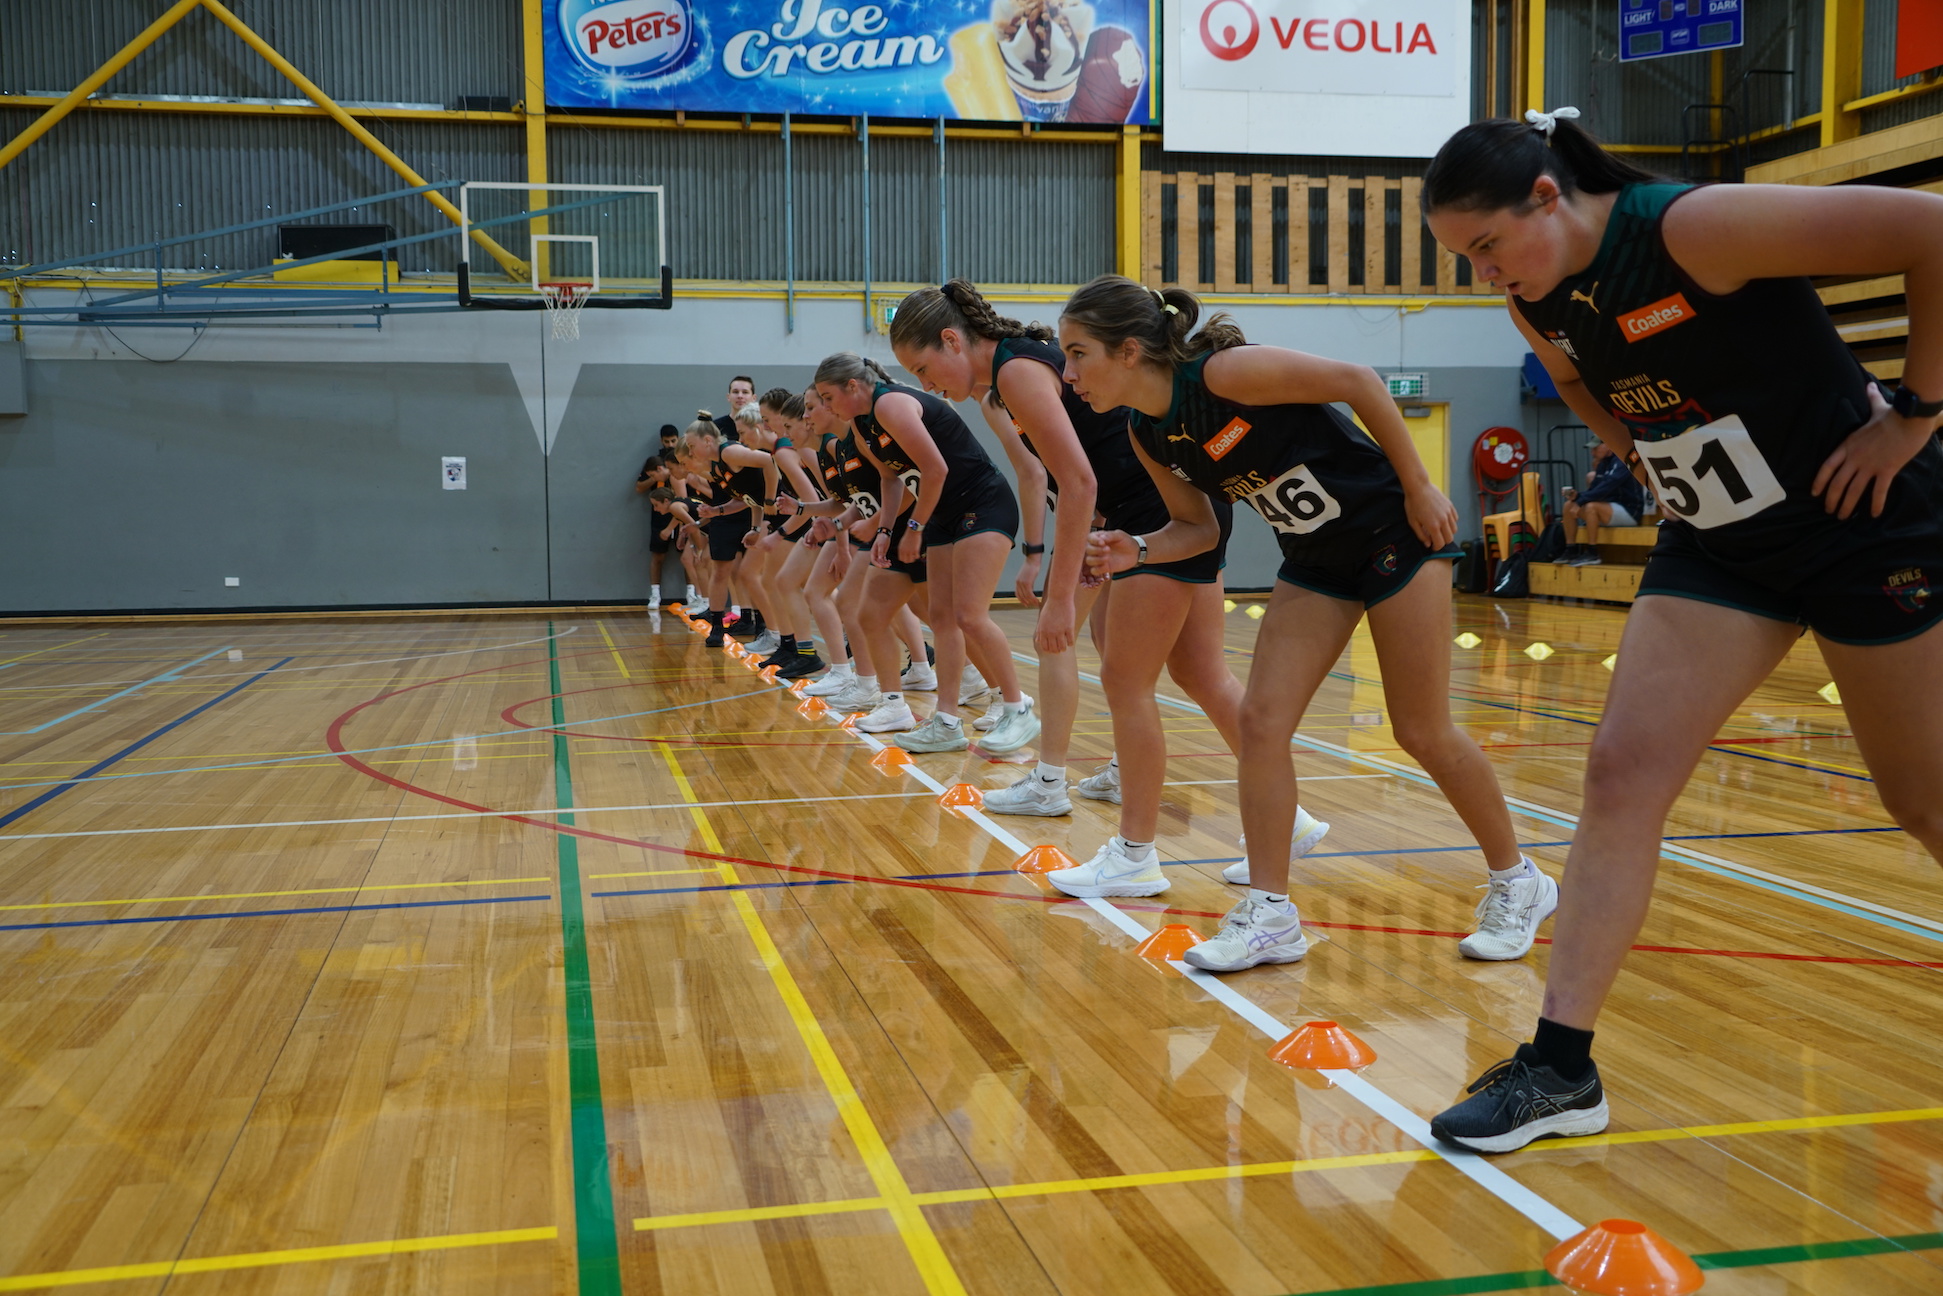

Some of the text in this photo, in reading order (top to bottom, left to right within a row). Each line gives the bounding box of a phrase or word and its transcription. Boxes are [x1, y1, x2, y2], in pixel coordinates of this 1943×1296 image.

[582, 11, 682, 55] Peters
[771, 0, 889, 41] Ice
[1269, 16, 1438, 55] VEOLIA
[722, 30, 945, 80] Cream
[1627, 304, 1683, 334] Coates
[1609, 380, 1681, 414] DEVILS
[1610, 373, 1651, 391] TASMANIA
[1210, 425, 1244, 455] Coates
[1647, 438, 1753, 516] 51
[1254, 478, 1326, 527] 46
[1888, 568, 1922, 587] DEVILS
